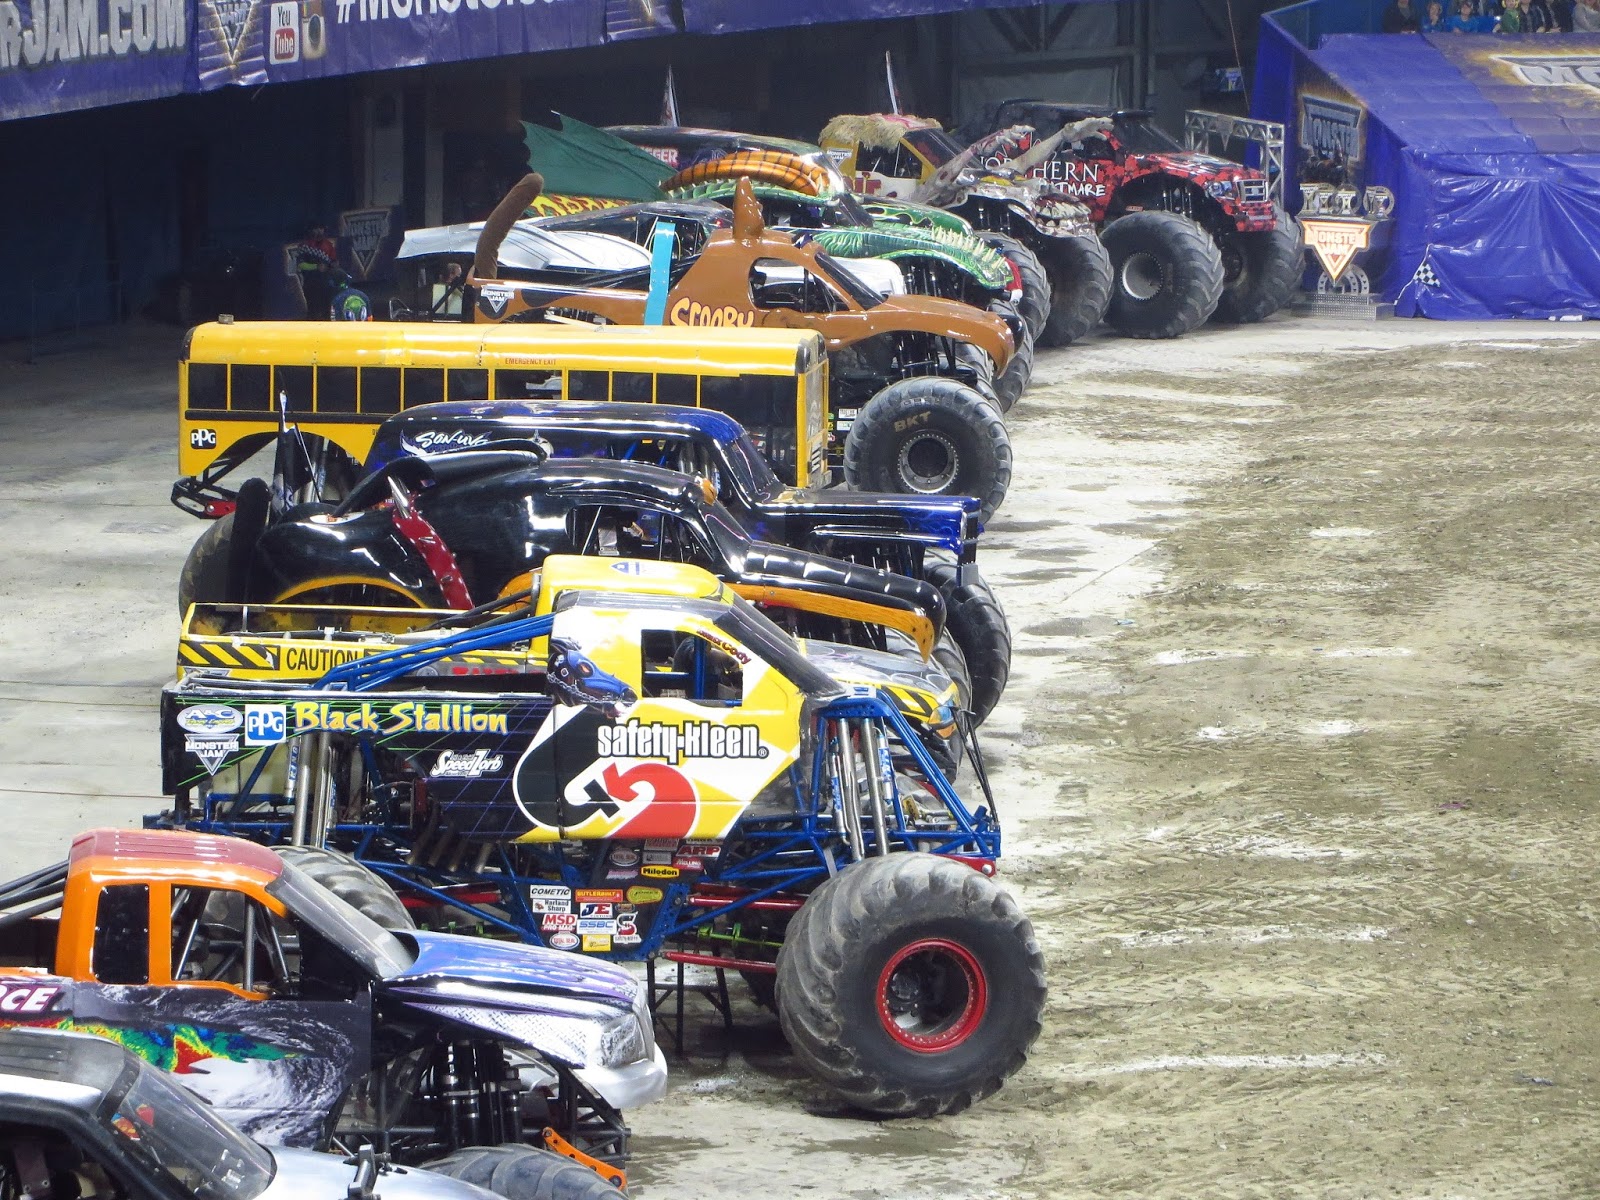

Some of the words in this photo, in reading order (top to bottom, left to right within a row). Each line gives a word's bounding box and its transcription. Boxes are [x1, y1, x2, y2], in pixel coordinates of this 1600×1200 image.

[277, 6, 291, 27] You
[275, 33, 294, 55] Tube
[1050, 181, 1106, 197] TMARE
[894, 411, 931, 432] BKT
[191, 428, 216, 447] PPG
[247, 711, 283, 736] PPG
[292, 701, 379, 732] Black
[382, 701, 508, 735] Stallion
[185, 741, 239, 752] MONSTER
[200, 750, 224, 758] JAM
[430, 749, 504, 777] SpeedZorb
[679, 845, 720, 856] ARP
[642, 866, 678, 876] Milodon
[531, 887, 570, 896] COMETIC
[581, 903, 611, 916] JE
[544, 914, 576, 925] MSD
[578, 920, 615, 928] SSBC
[0, 984, 59, 1012] CE
